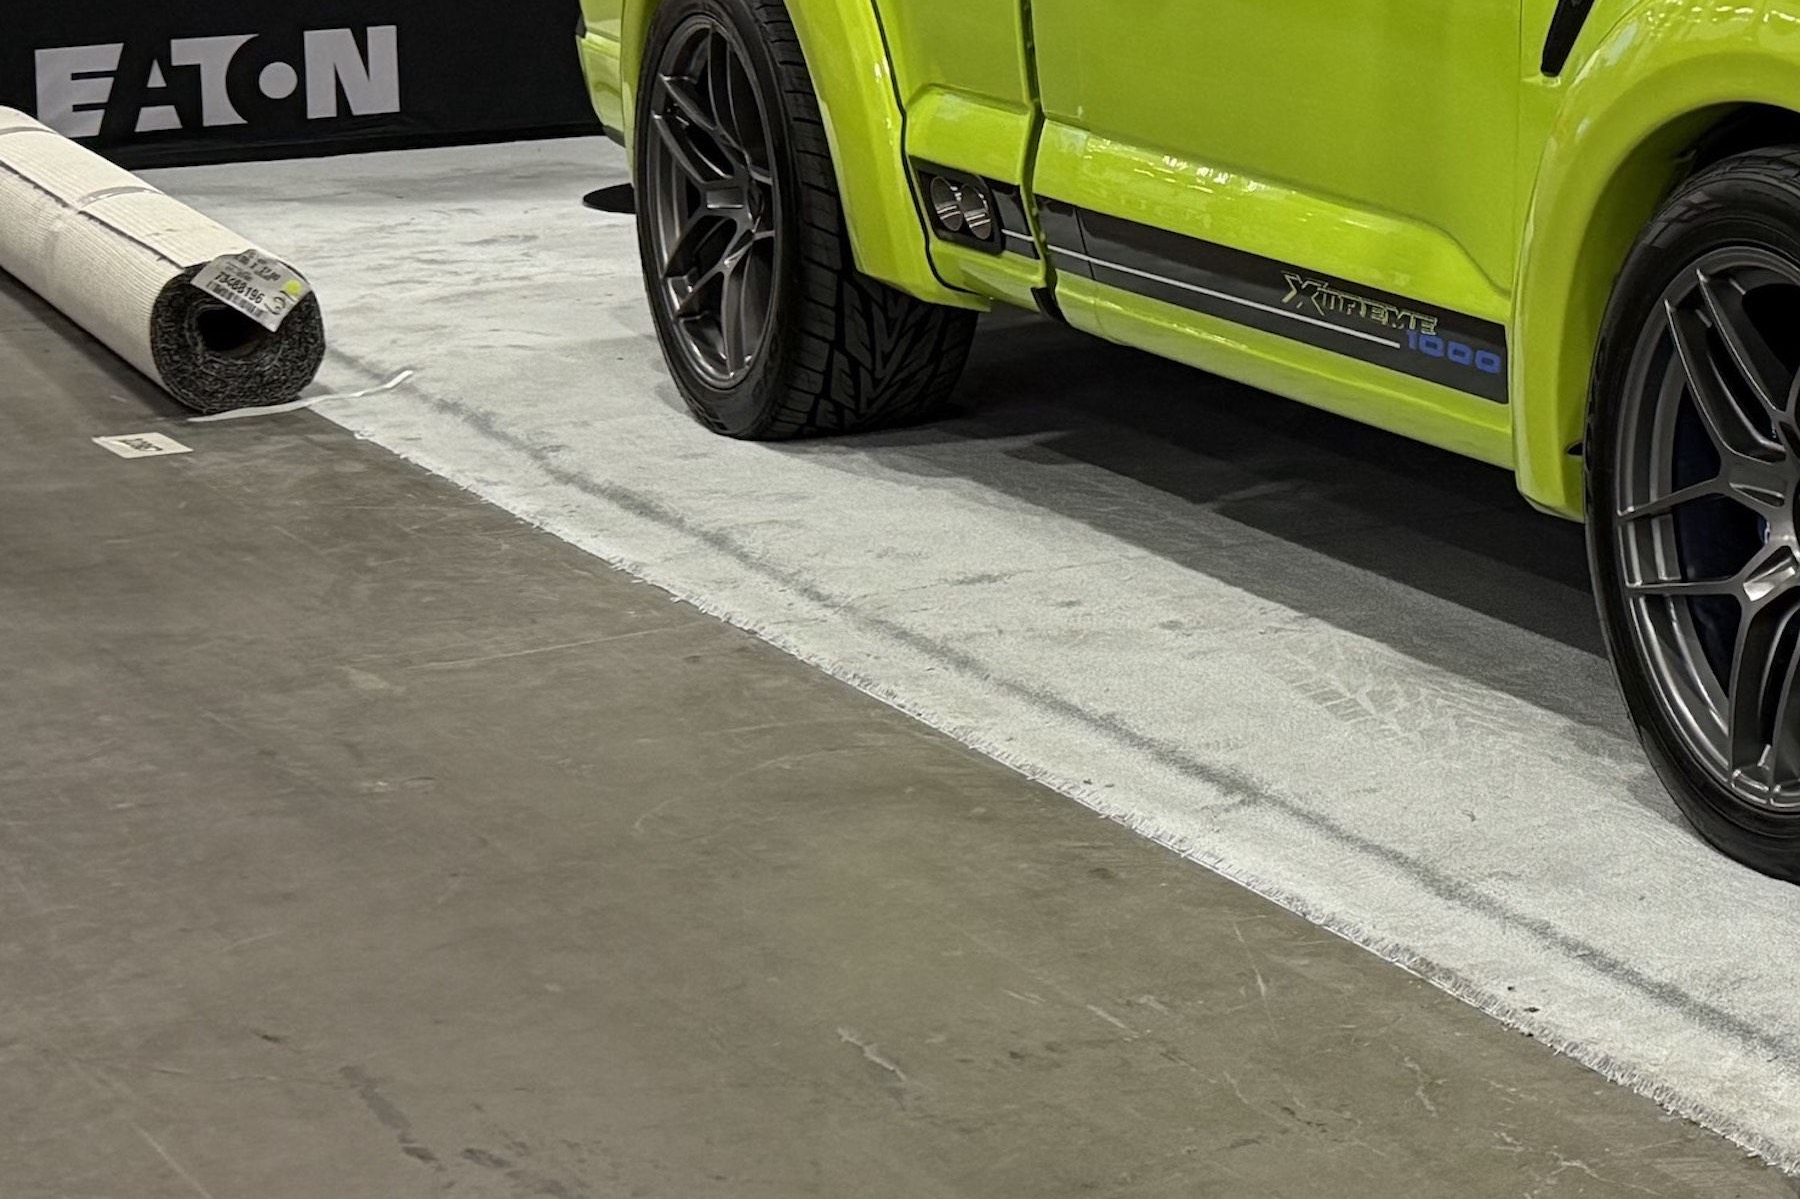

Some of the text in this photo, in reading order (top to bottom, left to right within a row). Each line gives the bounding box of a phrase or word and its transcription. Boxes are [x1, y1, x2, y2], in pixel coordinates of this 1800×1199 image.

[34, 25, 400, 139] EATON
[1281, 271, 1438, 336] XTREME
[1406, 329, 1501, 375] 1000
